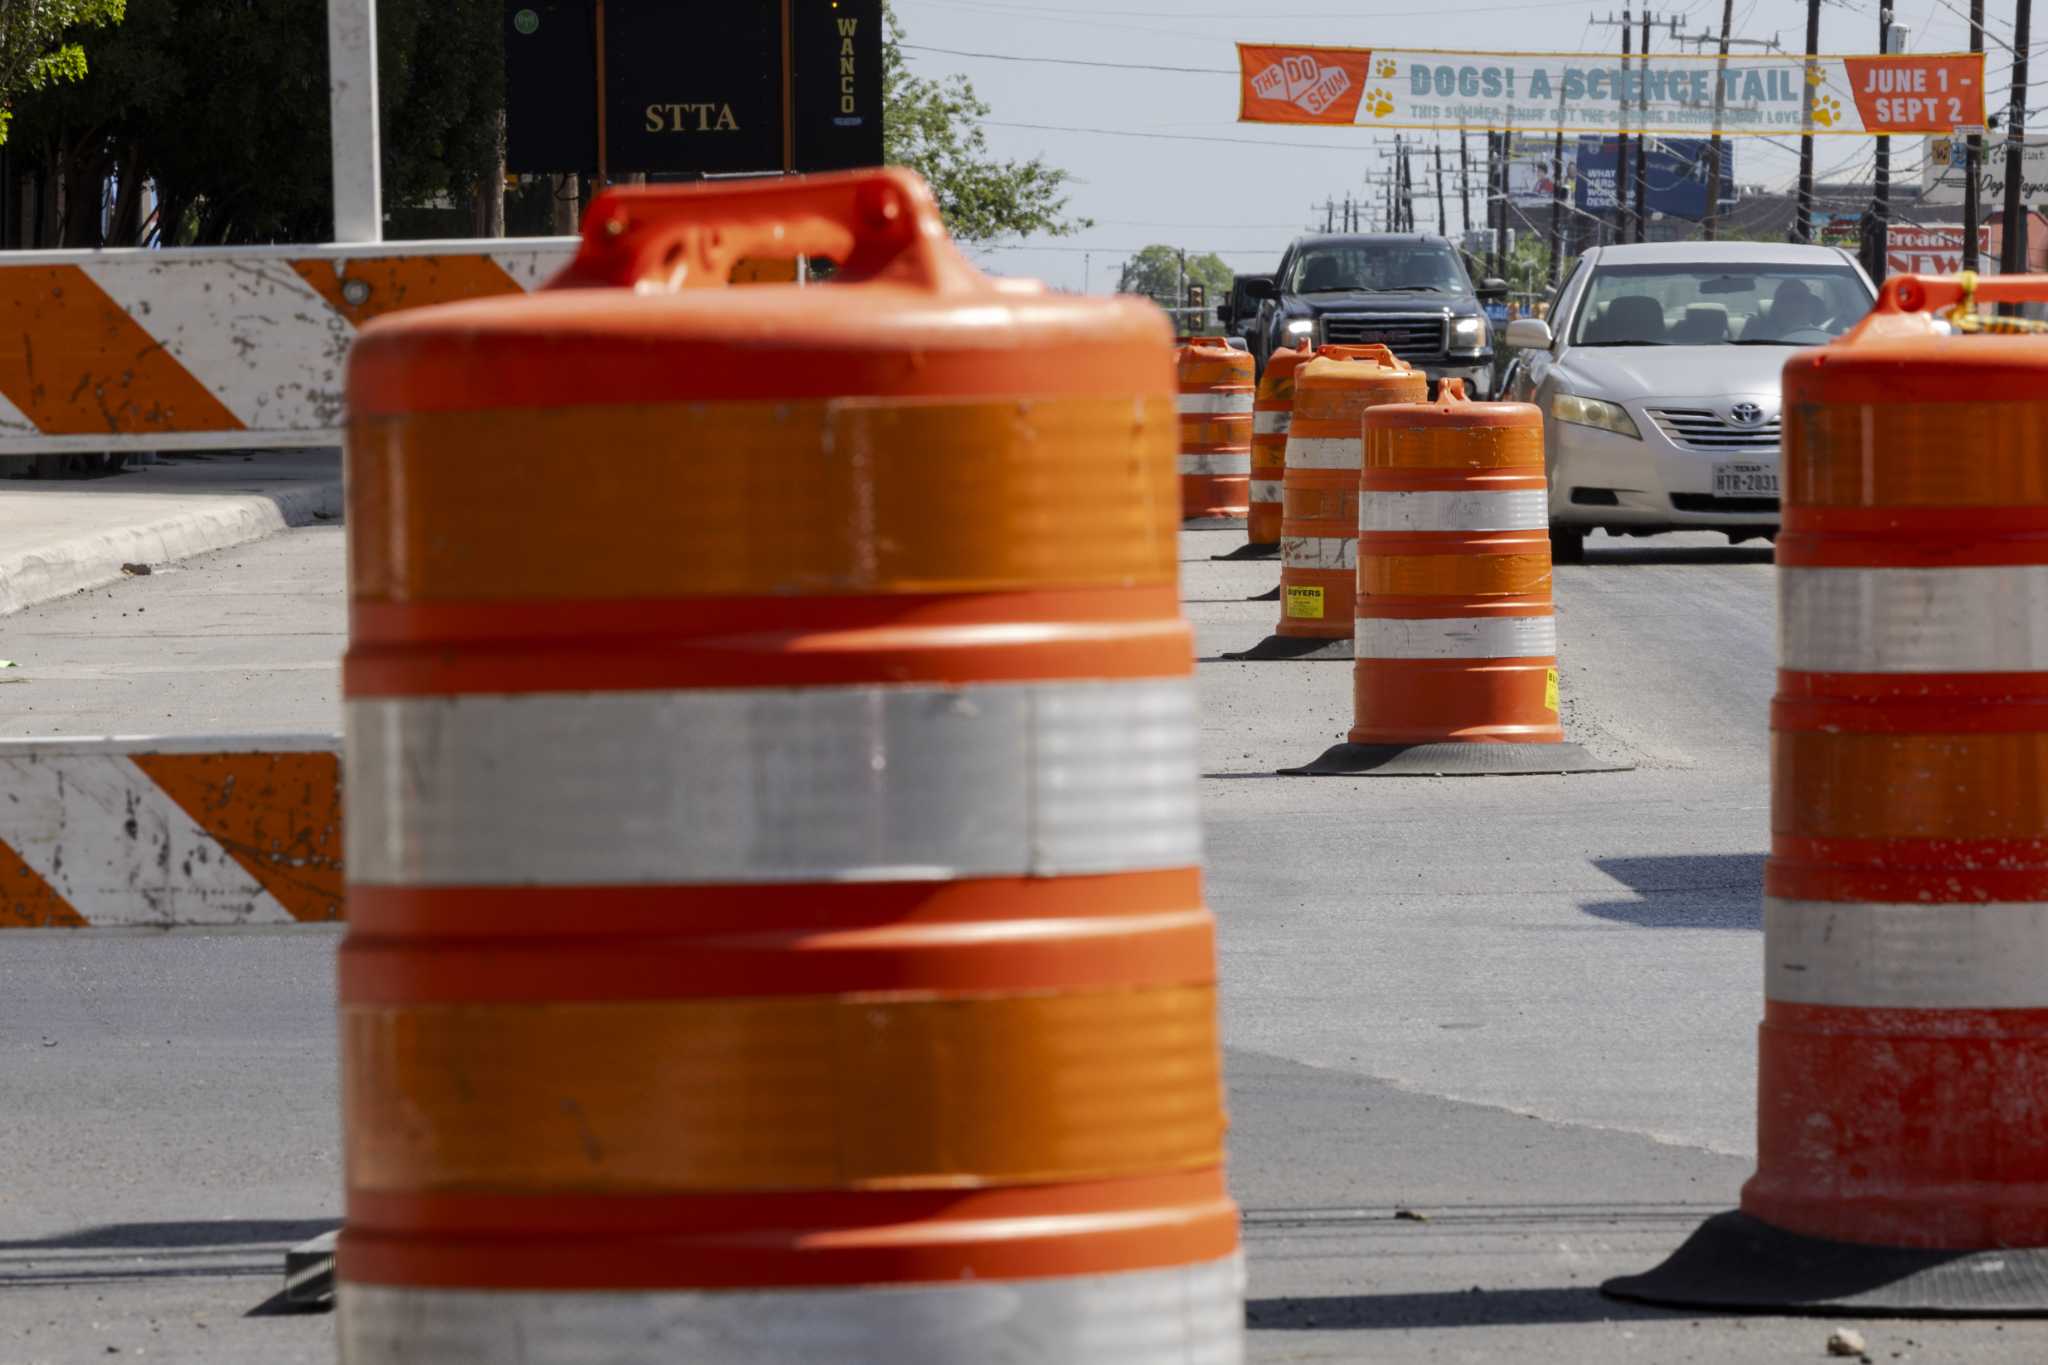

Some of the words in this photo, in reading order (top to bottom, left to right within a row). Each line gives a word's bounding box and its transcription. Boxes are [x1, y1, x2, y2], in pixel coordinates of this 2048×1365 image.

[837, 18, 858, 113] WANCO
[1254, 67, 1282, 95] THE
[1286, 58, 1316, 83] DO
[1307, 70, 1347, 111] SEUM
[1410, 64, 1514, 98] DOGS!
[1529, 68, 1553, 99] A
[1565, 68, 1710, 101] SCIENCE
[1721, 69, 1798, 101] TAIL
[1864, 68, 1927, 93] JUNE
[1937, 68, 1948, 92] 1
[645, 103, 741, 132] STTA
[1410, 104, 1440, 118] THIS
[1767, 110, 1800, 125] LOVE
[1875, 97, 1939, 123] SEPT
[1947, 97, 1963, 122] 2
[1587, 169, 1617, 178] WHAT
